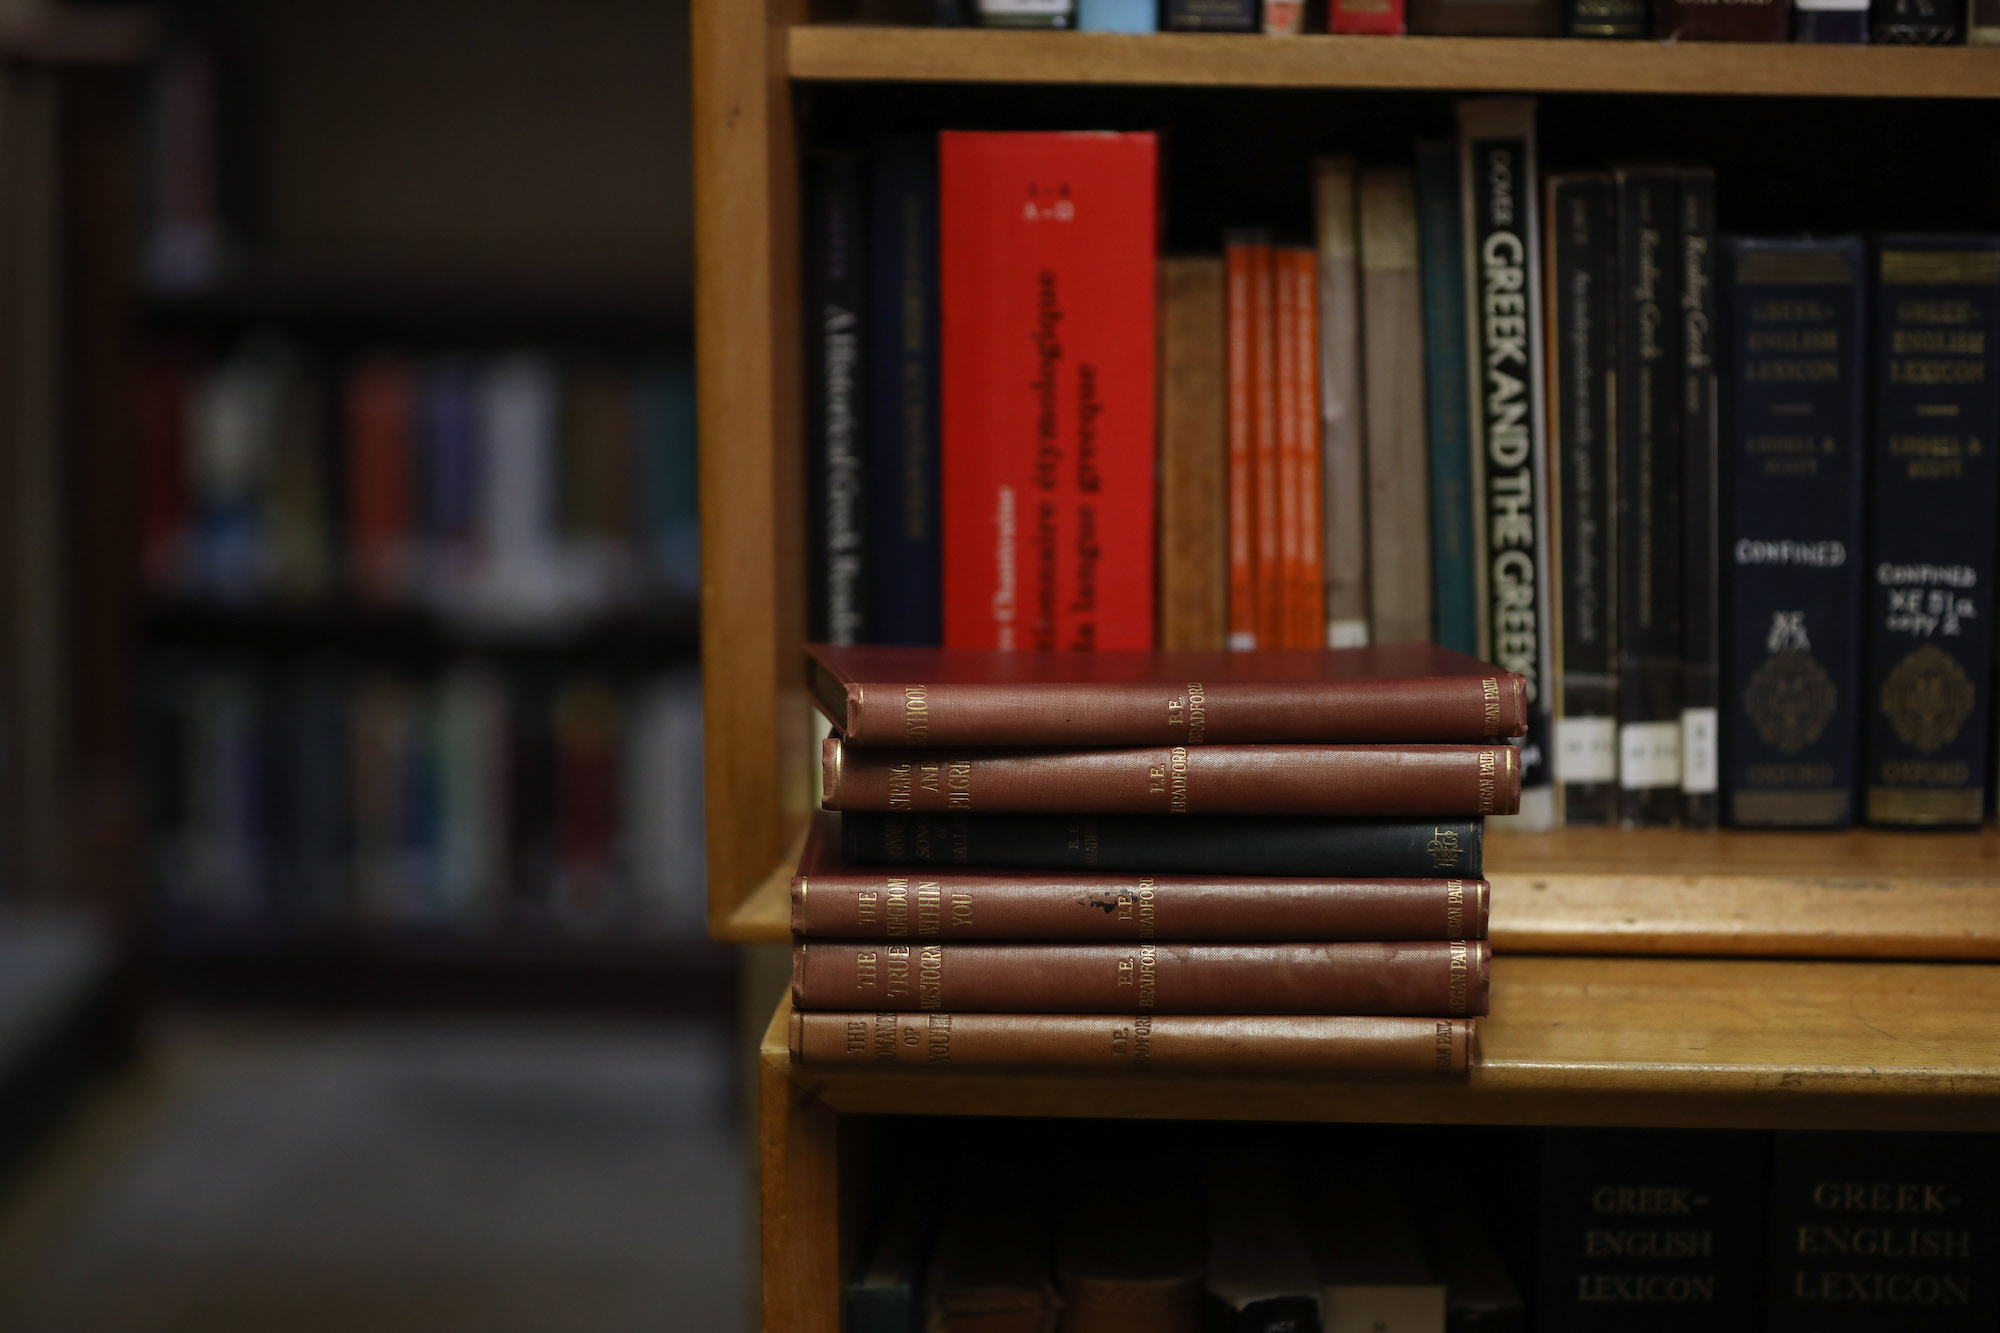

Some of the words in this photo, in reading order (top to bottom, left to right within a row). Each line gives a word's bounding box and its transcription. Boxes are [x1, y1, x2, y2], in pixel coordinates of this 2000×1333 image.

[1484, 230, 1527, 366] GREEK
[1487, 367, 1530, 469] AND
[1490, 466, 1534, 549] THE
[1734, 538, 1847, 567] CONFINED
[1877, 562, 1977, 587] CONFINED
[828, 553, 862, 647] Reade
[1482, 677, 1500, 700] PAUL
[920, 761, 939, 793] AND
[1172, 746, 1187, 814] BRADFORD
[1479, 750, 1496, 776] PAUL
[889, 762, 912, 810] STRANG
[858, 892, 877, 925] THE
[887, 878, 909, 937] KINGDOM
[918, 881, 941, 935] WITHIN
[1448, 879, 1464, 905] PAUL
[952, 893, 973, 927] YOU
[857, 952, 877, 991] THE
[888, 945, 910, 999] TRUE
[1451, 939, 1467, 971] PAUL
[920, 944, 942, 1010] ARISTOCRA
[848, 1022, 867, 1055] THE
[904, 1028, 922, 1046] OF
[1584, 1229, 1715, 1258] ENGLISH
[1798, 1225, 1973, 1259] ENGLISH
[1578, 1275, 1718, 1302] LEXICON
[1793, 1269, 1974, 1303] LEXICON
